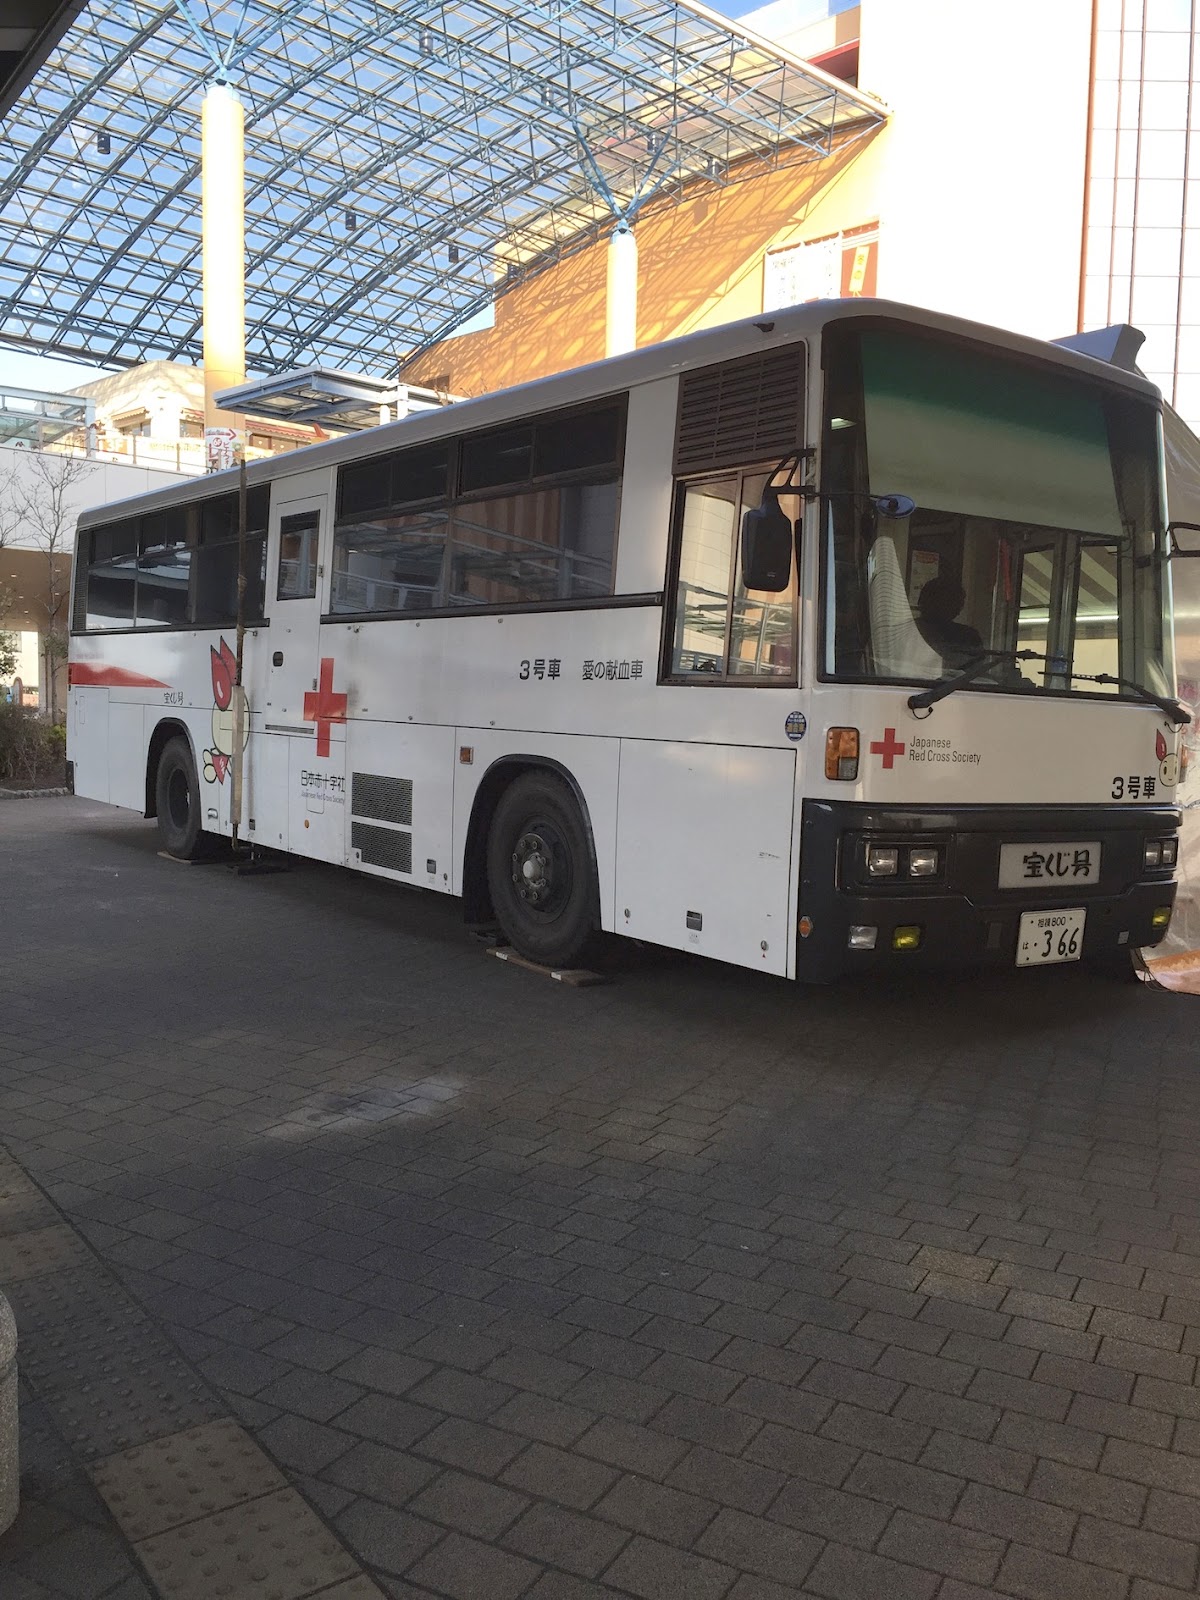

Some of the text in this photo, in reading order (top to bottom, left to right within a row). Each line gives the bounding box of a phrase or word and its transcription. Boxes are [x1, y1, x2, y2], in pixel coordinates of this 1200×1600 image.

[519, 658, 643, 681] 3号車 愛の献血車
[909, 735, 951, 749] Japanese
[909, 749, 981, 765] Red Cross Society
[1111, 776, 1156, 799] 3号車
[1022, 849, 1092, 878] 宝くじ号
